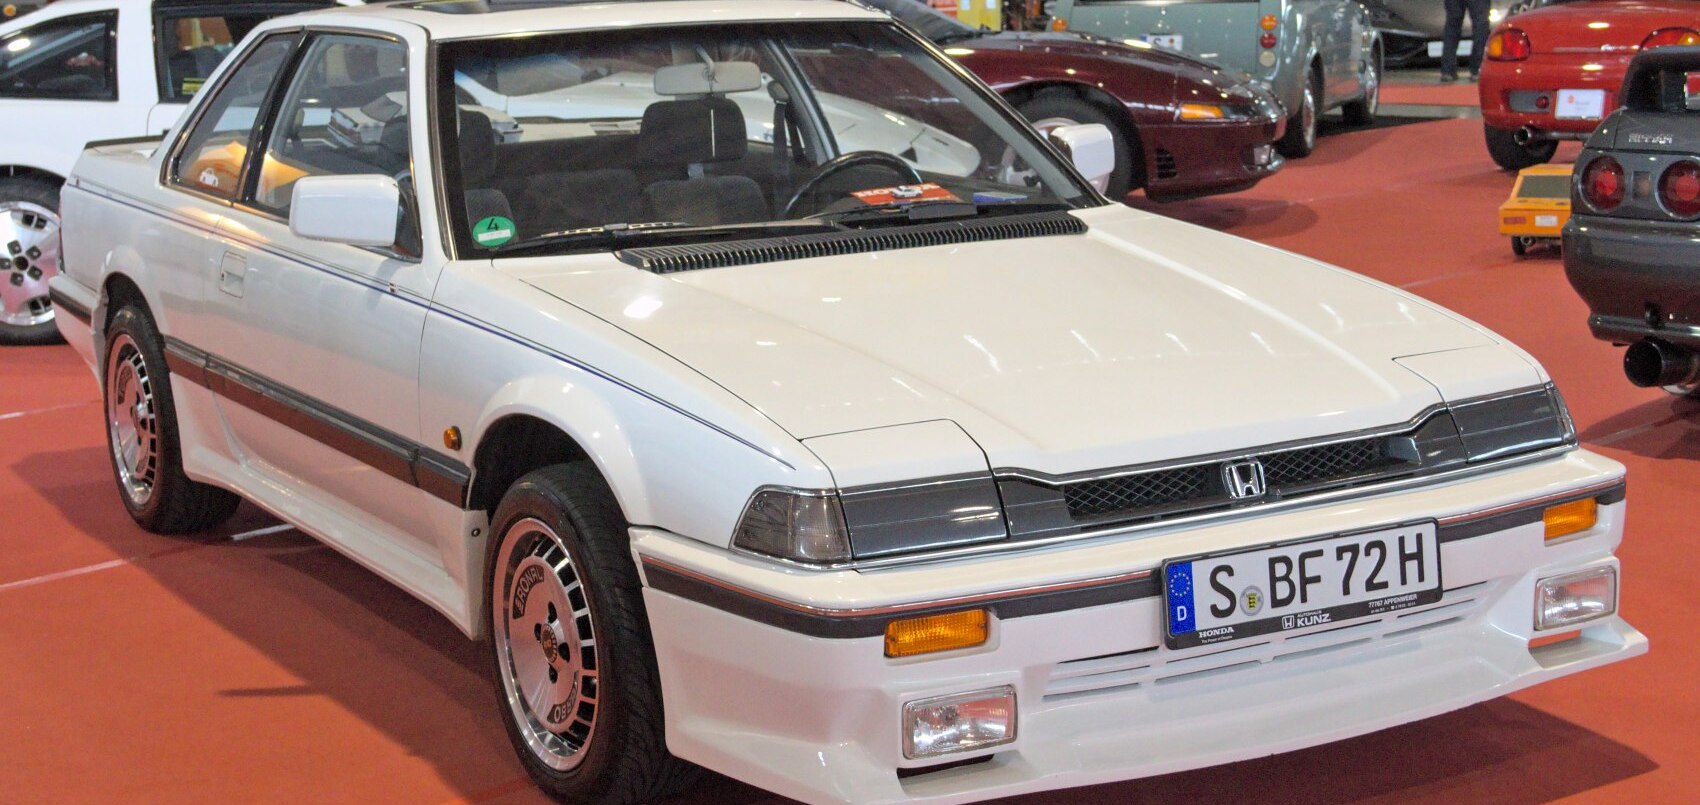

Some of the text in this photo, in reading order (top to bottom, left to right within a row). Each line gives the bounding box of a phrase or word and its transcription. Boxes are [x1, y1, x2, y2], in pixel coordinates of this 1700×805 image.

[487, 217, 498, 231] 4
[1209, 533, 1425, 619] S BF 72 H
[1176, 606, 1187, 621] D
[1297, 613, 1331, 627] KUNZ
[1199, 627, 1234, 637] HONDA
